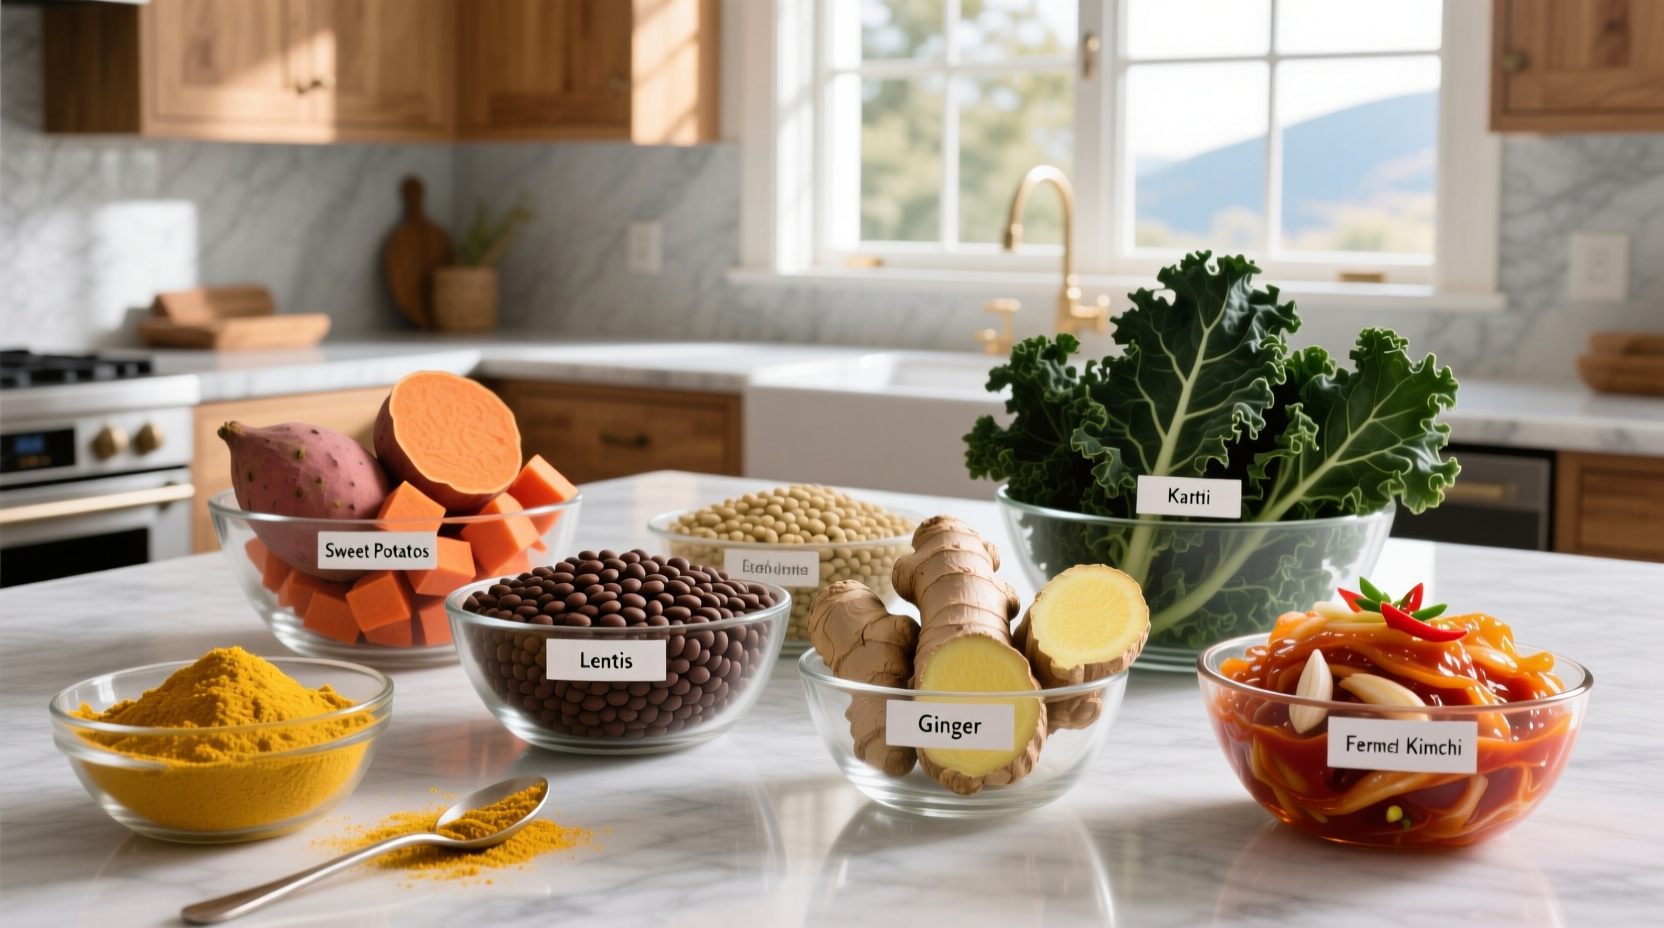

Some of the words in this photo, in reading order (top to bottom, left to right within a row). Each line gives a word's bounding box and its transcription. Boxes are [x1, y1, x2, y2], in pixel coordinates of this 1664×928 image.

[325, 542, 370, 559] Sweet
[374, 542, 430, 559] Potatos
[918, 713, 983, 740] Ginger
[1406, 736, 1462, 756] Kimchi
